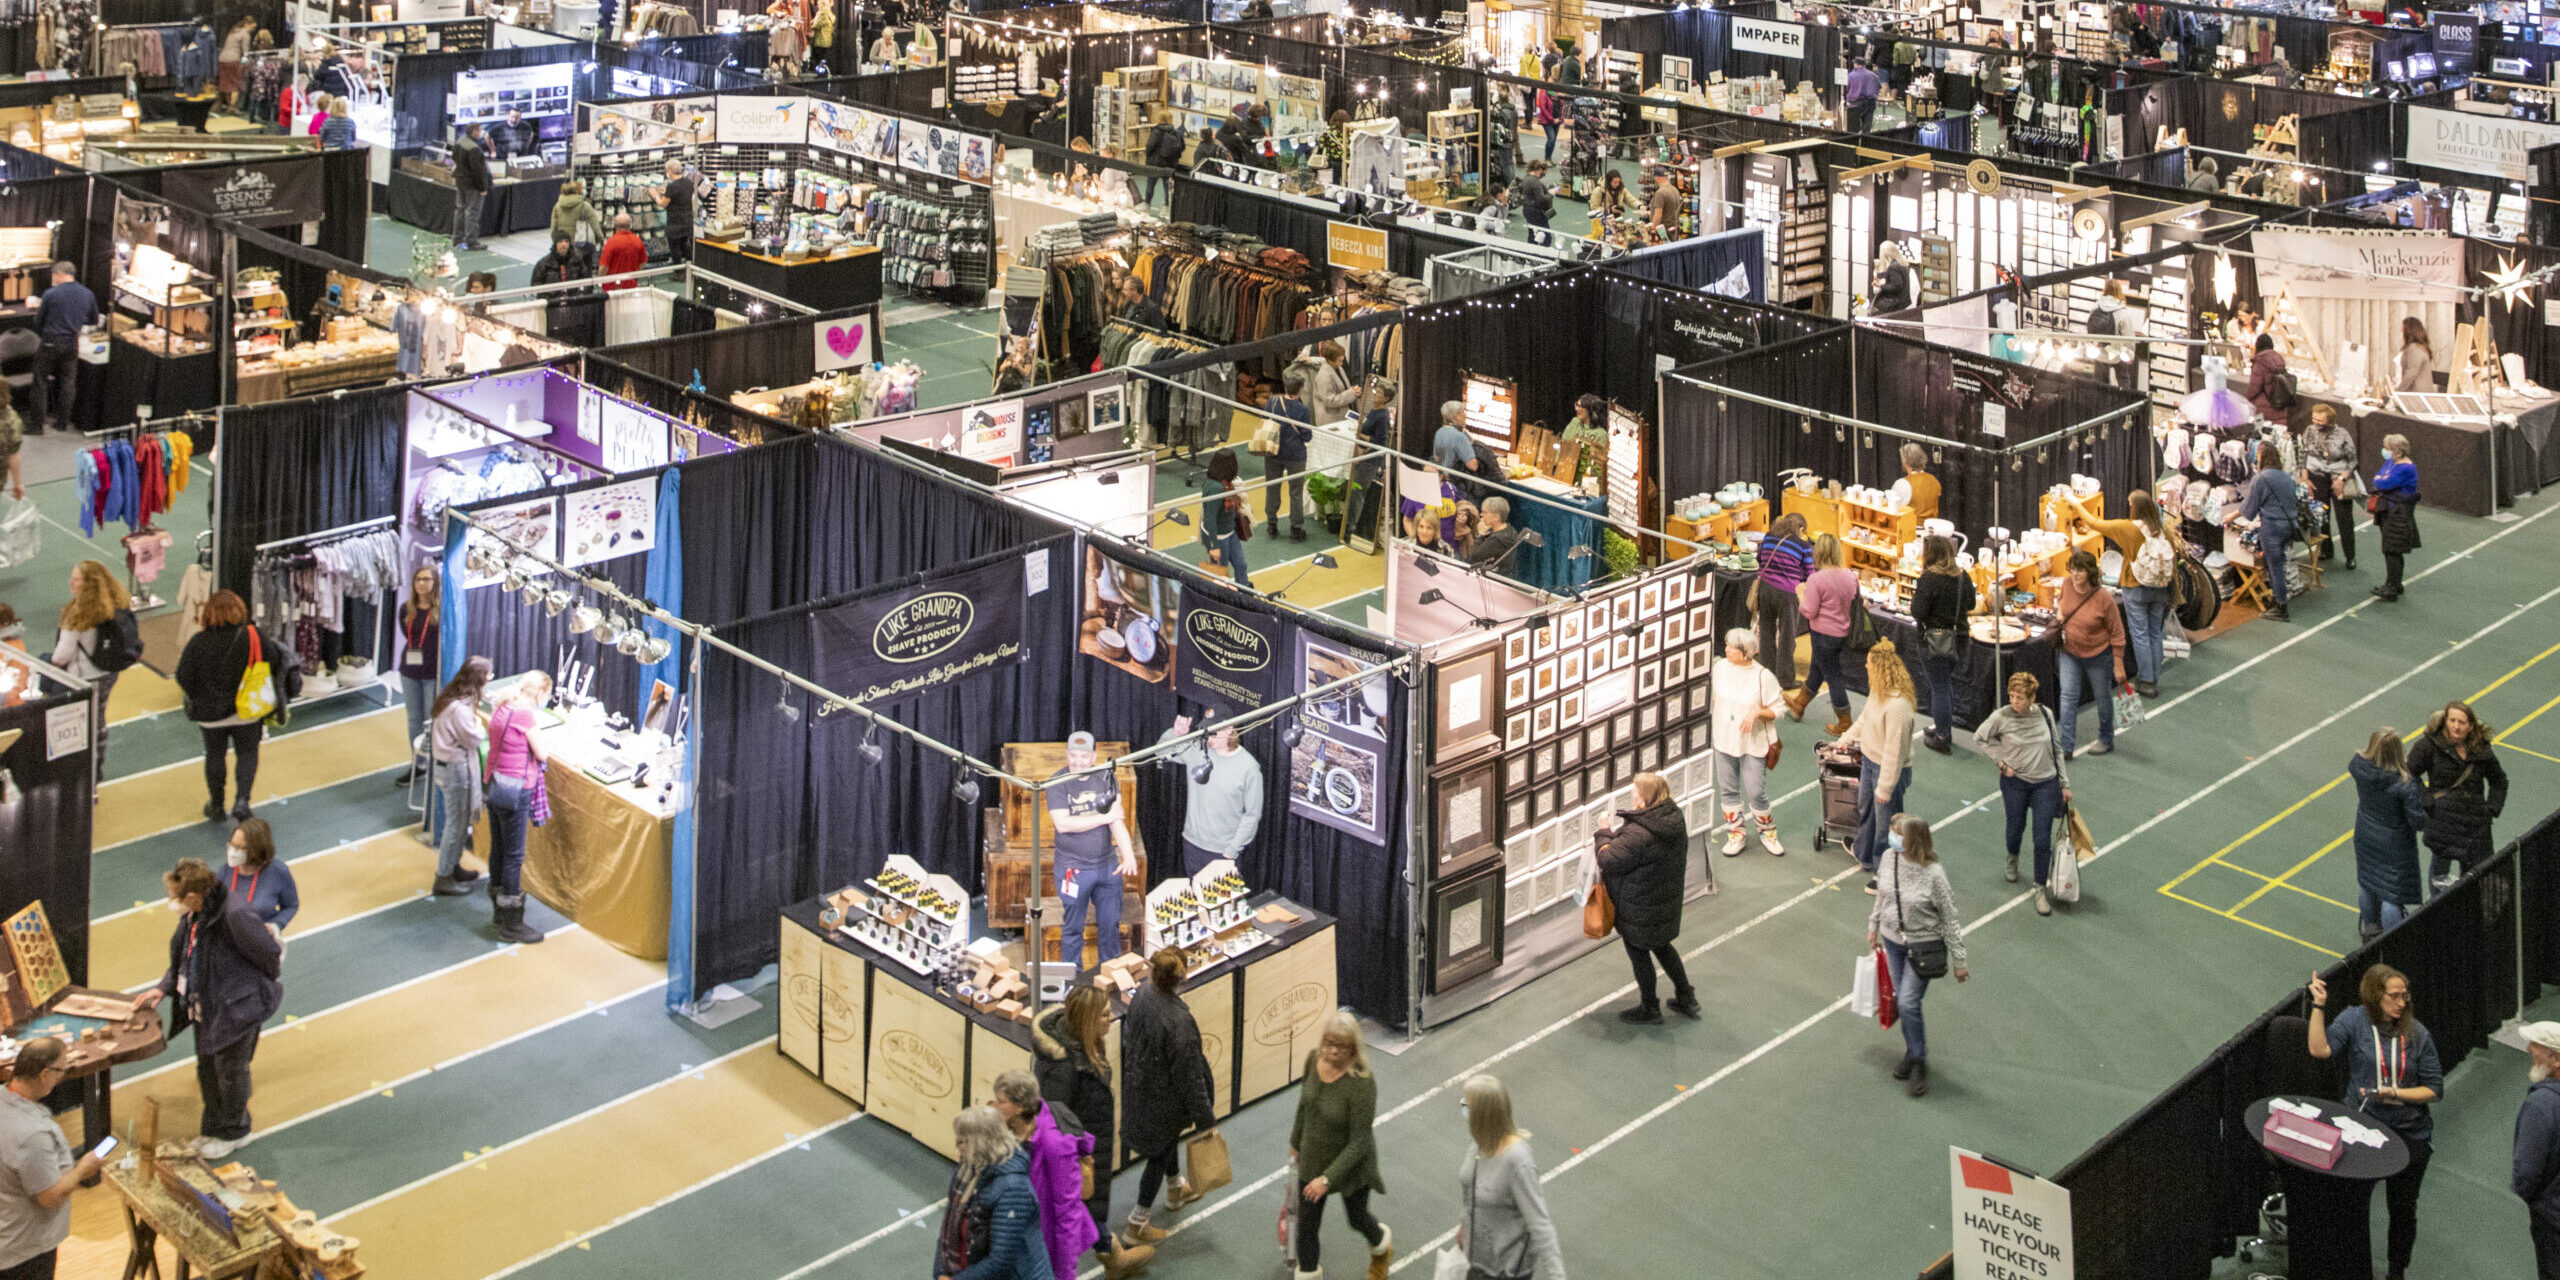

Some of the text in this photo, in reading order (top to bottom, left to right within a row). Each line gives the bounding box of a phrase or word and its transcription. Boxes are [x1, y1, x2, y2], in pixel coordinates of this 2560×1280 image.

[1737, 26, 1799, 46] IMPAPER
[730, 110, 779, 125] Colibri
[216, 189, 273, 204] ESSENCE
[1331, 237, 1384, 259] REBECCA KING
[2359, 248, 2455, 267] Mackenzie
[1673, 319, 1707, 339] Bayleigh
[1707, 327, 1743, 349] Jewellery
[1952, 358, 2003, 376] urban forest design
[881, 597, 962, 642] LIKE GRANDPA
[1194, 614, 1214, 631] LIKE
[1212, 616, 1259, 651] GRANDPA
[888, 623, 960, 654] SHAVE PRODUCTS
[1195, 635, 1223, 654] GROOMING
[1223, 650, 1260, 664] PRODUCTS
[890, 675, 925, 694] Products
[943, 662, 972, 682] Grandpa
[1194, 676, 1215, 690] STANDS
[1215, 685, 1227, 695] THE
[1227, 689, 1239, 700] TEST
[1246, 698, 1261, 708] TIME
[1222, 681, 1246, 695] QUALITY
[1246, 690, 1262, 701] THAT
[55, 726, 78, 742] 301
[1261, 1003, 1281, 1028] LIKE
[1982, 1196, 2042, 1232] PLEASE
[1964, 1211, 2061, 1262] HAVE YOUR
[1978, 1237, 2048, 1277] TICKETS
